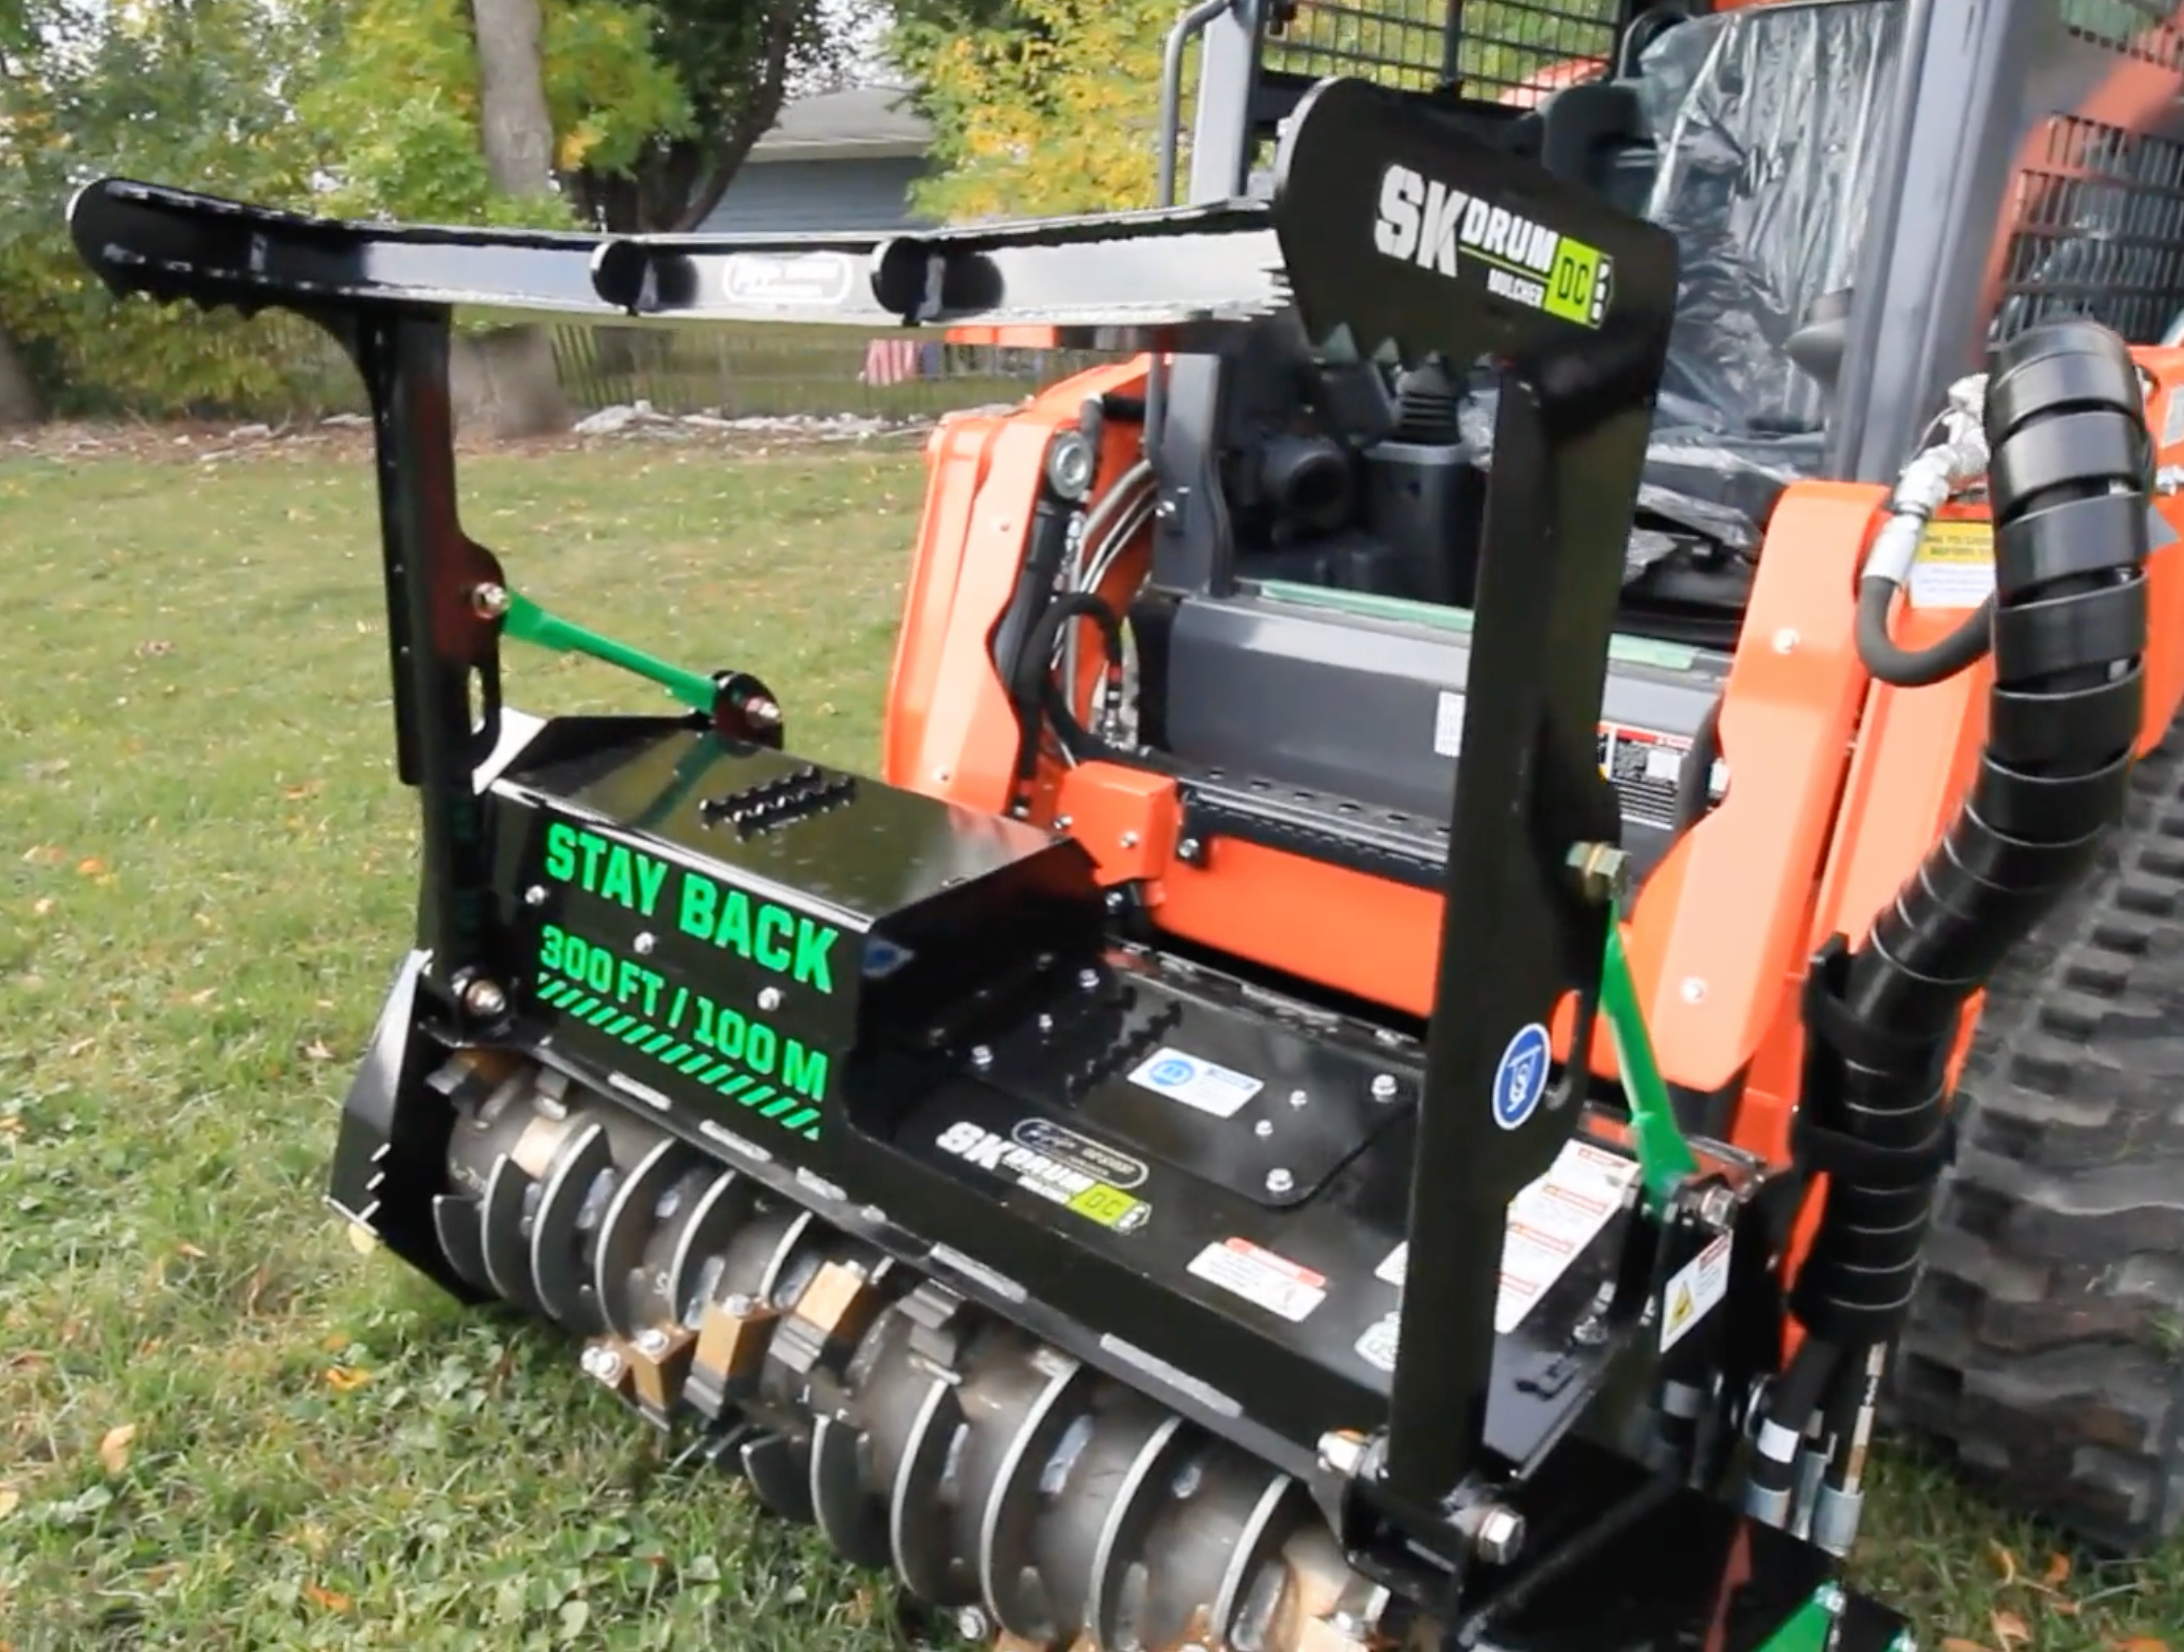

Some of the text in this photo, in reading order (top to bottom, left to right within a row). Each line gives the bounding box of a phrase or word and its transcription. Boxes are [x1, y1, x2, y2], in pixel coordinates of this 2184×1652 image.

[1374, 164, 1590, 306] SK DRUM DC
[545, 822, 839, 995] STAY BACK
[539, 924, 614, 994] 300
[617, 959, 665, 1018] FT
[693, 995, 777, 1075] 100
[781, 1038, 829, 1103] M
